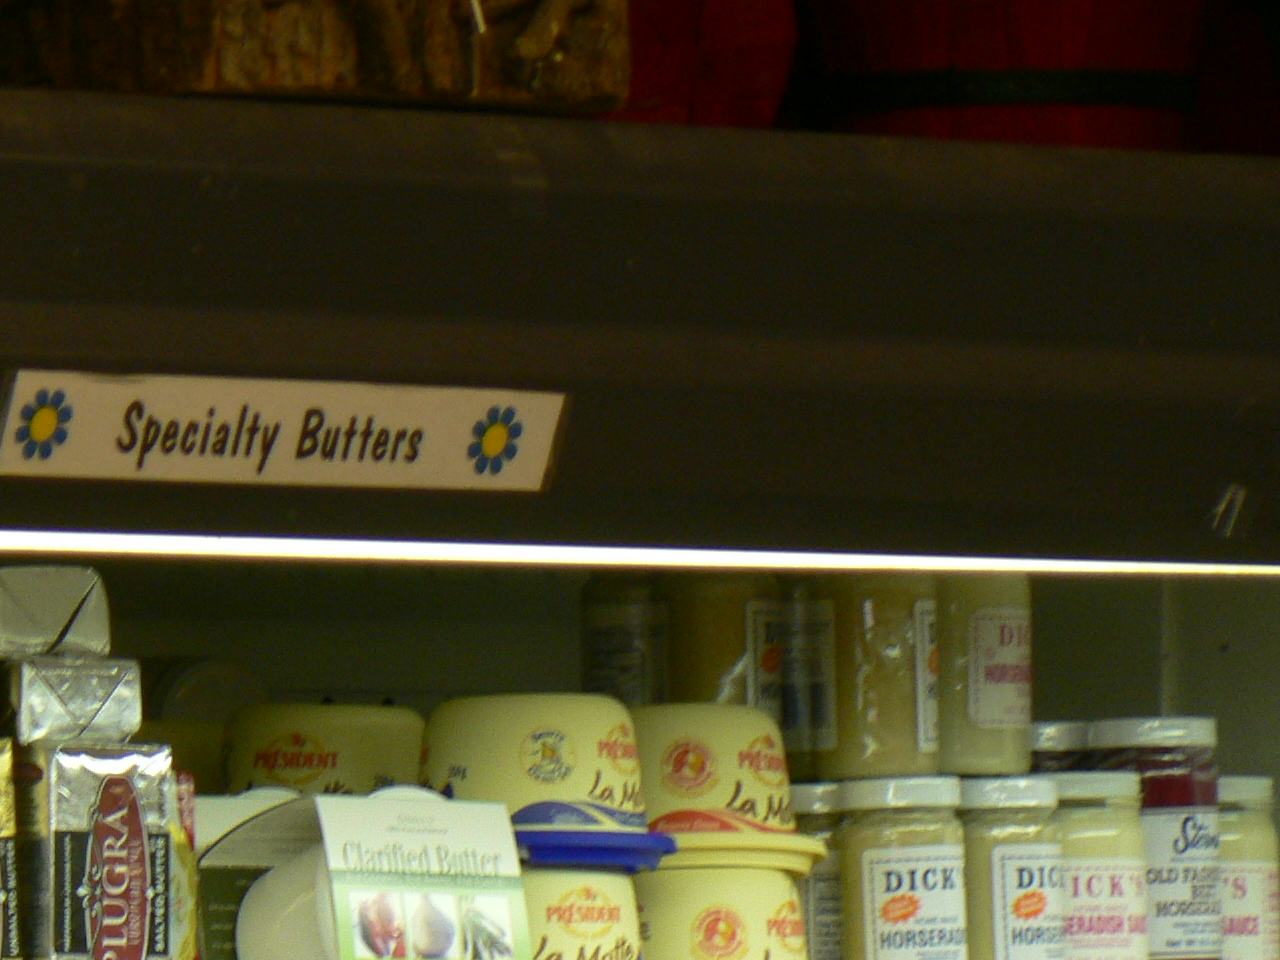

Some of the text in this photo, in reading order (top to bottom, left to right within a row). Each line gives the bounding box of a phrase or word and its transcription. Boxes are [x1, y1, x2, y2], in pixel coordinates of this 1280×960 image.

[116, 399, 424, 475] Specialty Butters
[153, 837, 167, 953] SALTED BUTTER
[342, 840, 502, 876] Clarified Butter
